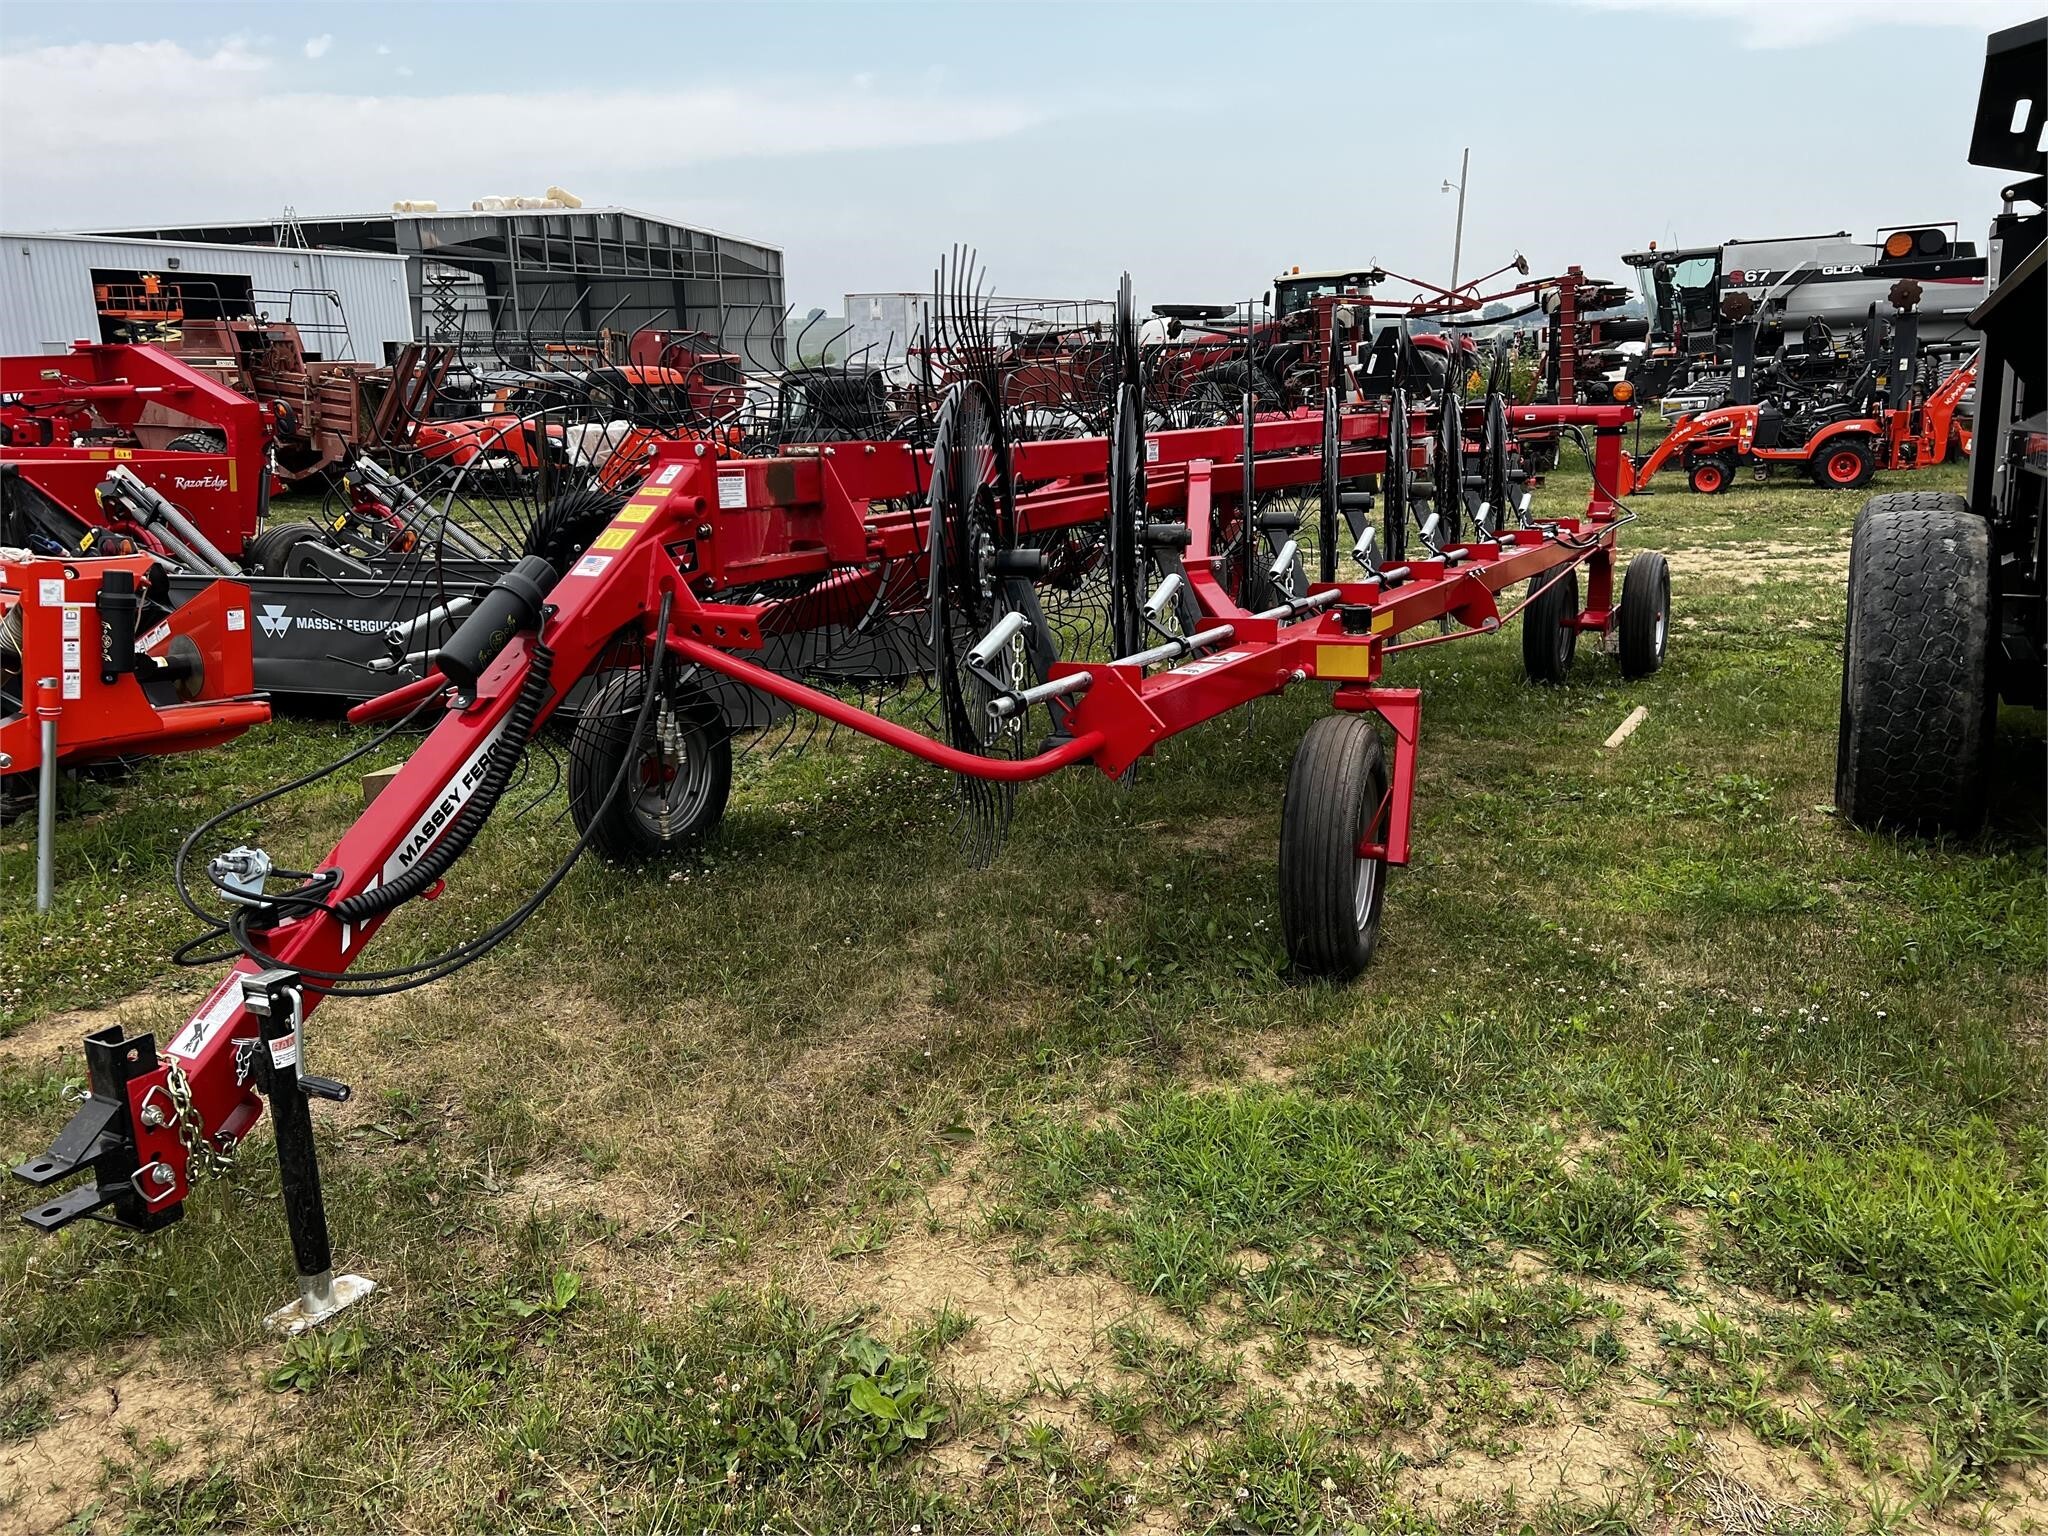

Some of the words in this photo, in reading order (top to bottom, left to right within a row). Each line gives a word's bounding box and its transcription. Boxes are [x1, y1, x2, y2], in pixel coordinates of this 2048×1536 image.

[1729, 269, 1771, 284] S67
[1822, 264, 1866, 275] GLEA
[1701, 416, 1729, 427] Kubota
[174, 475, 228, 491] RazorEdge
[296, 617, 343, 631] MASSEY
[347, 619, 405, 632] FERGUSO
[398, 787, 462, 868] MASSEY
